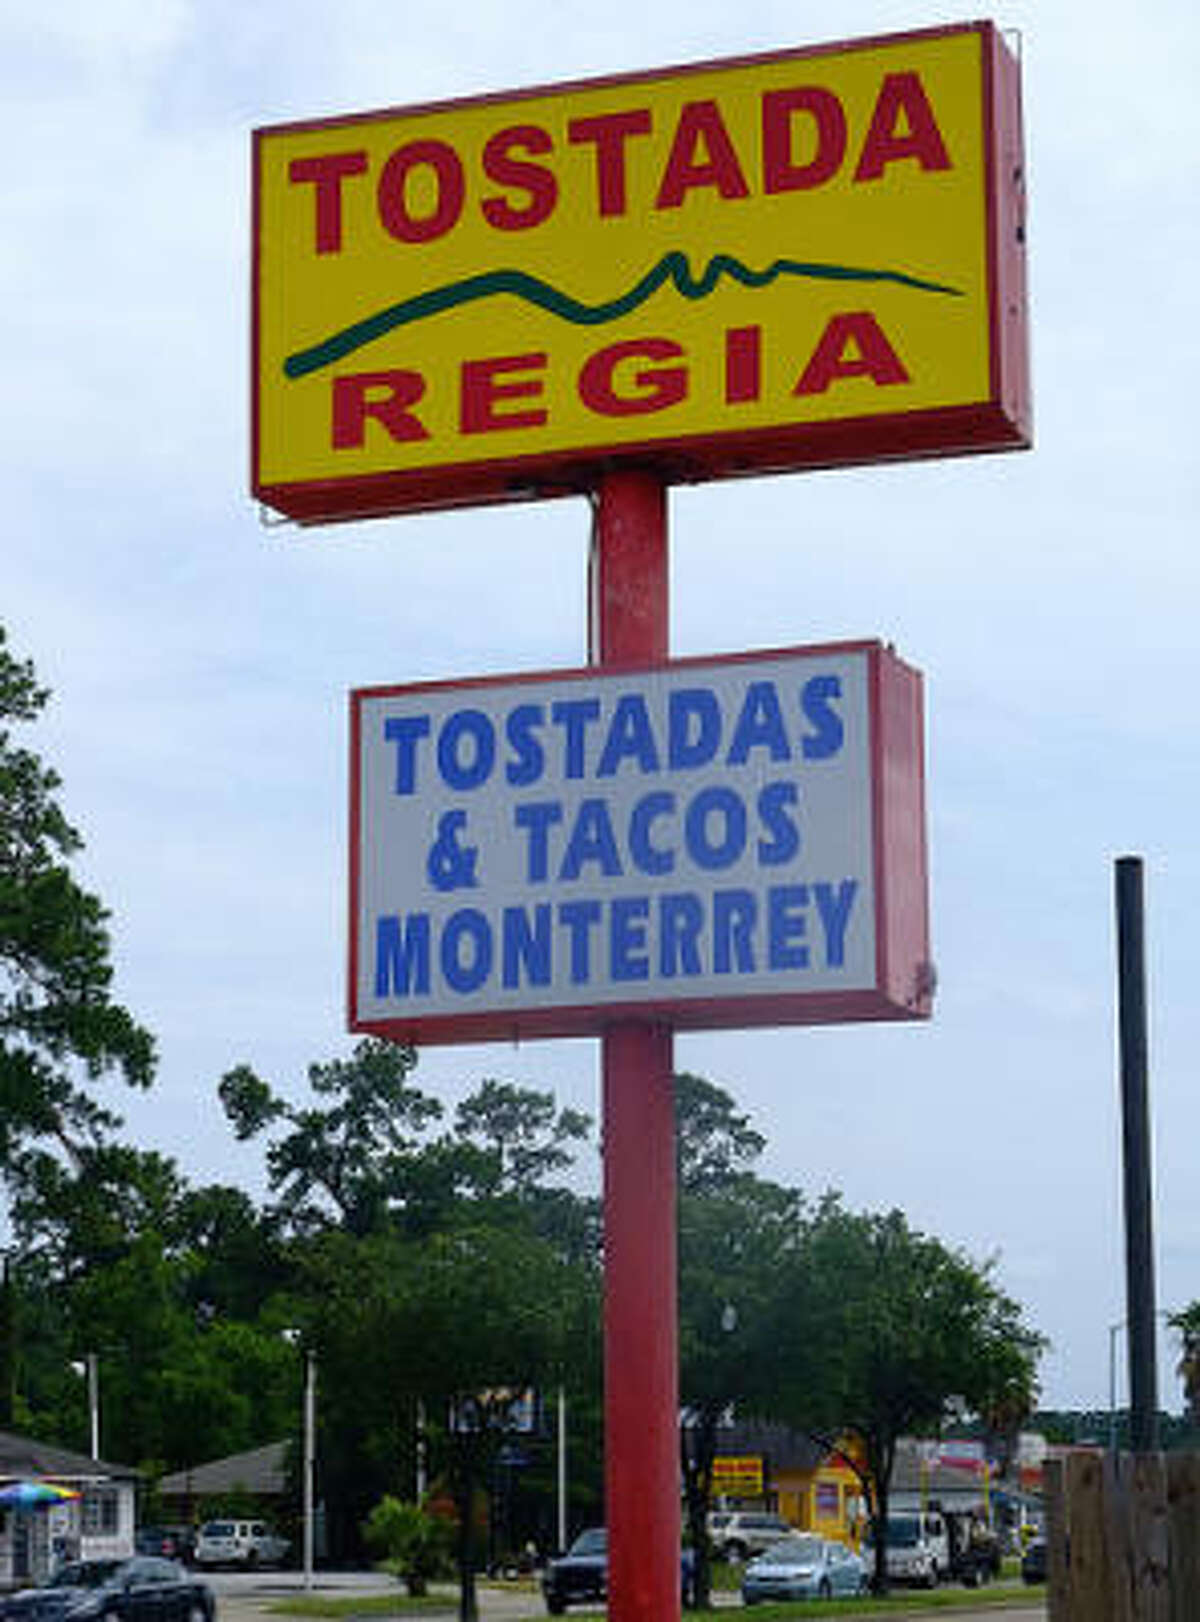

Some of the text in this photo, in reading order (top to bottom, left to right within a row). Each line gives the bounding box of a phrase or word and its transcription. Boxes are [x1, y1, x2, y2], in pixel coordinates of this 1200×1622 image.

[290, 72, 951, 253] TOSTADA
[331, 311, 910, 450] REGIA
[384, 675, 845, 797] TOSTADAS
[427, 780, 801, 893] & TACOS
[374, 879, 858, 999] MONTERREY
